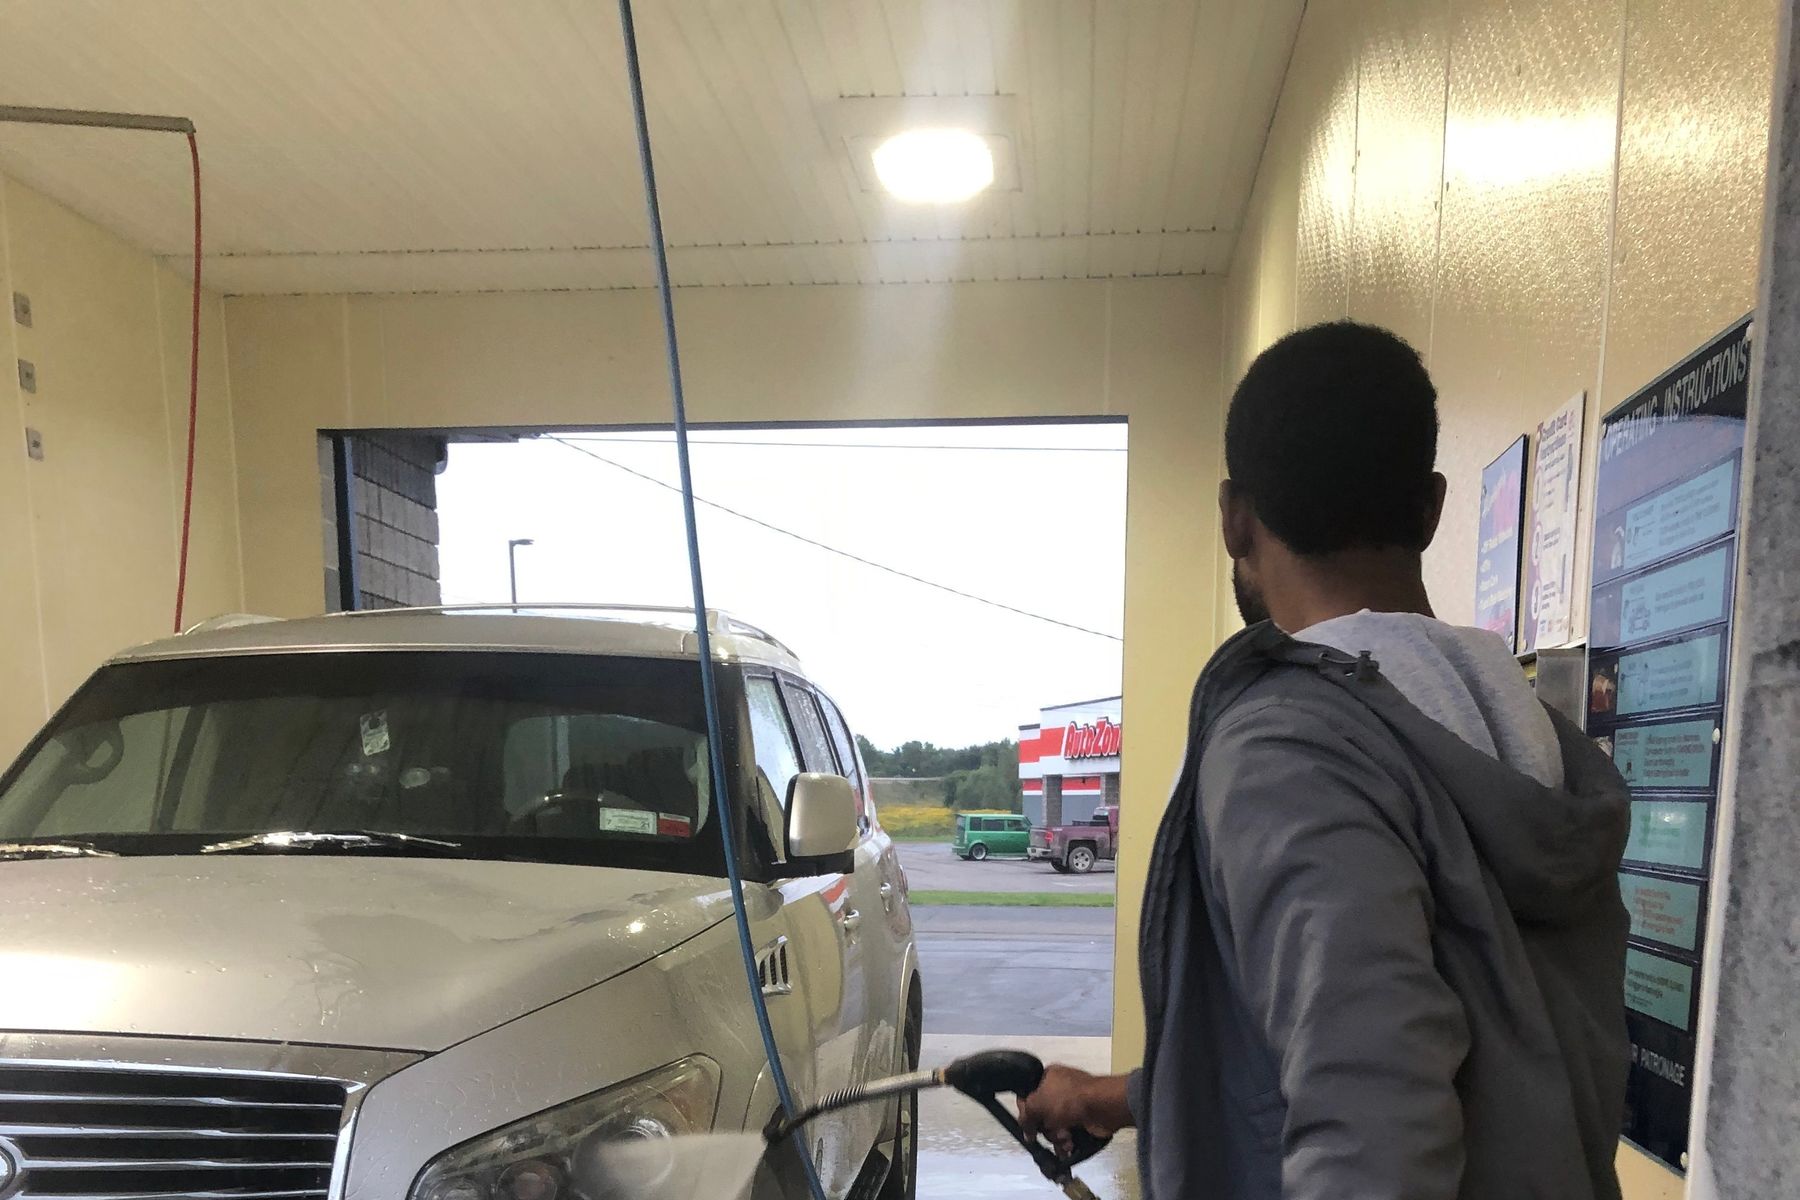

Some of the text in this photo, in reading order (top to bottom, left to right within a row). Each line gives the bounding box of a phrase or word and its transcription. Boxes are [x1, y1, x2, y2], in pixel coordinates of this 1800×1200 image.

[1653, 335, 1749, 424] INSTRUCTIONS
[1064, 716, 1120, 760] AutoZon
[1640, 1047, 1686, 1086] PATRONAGE
